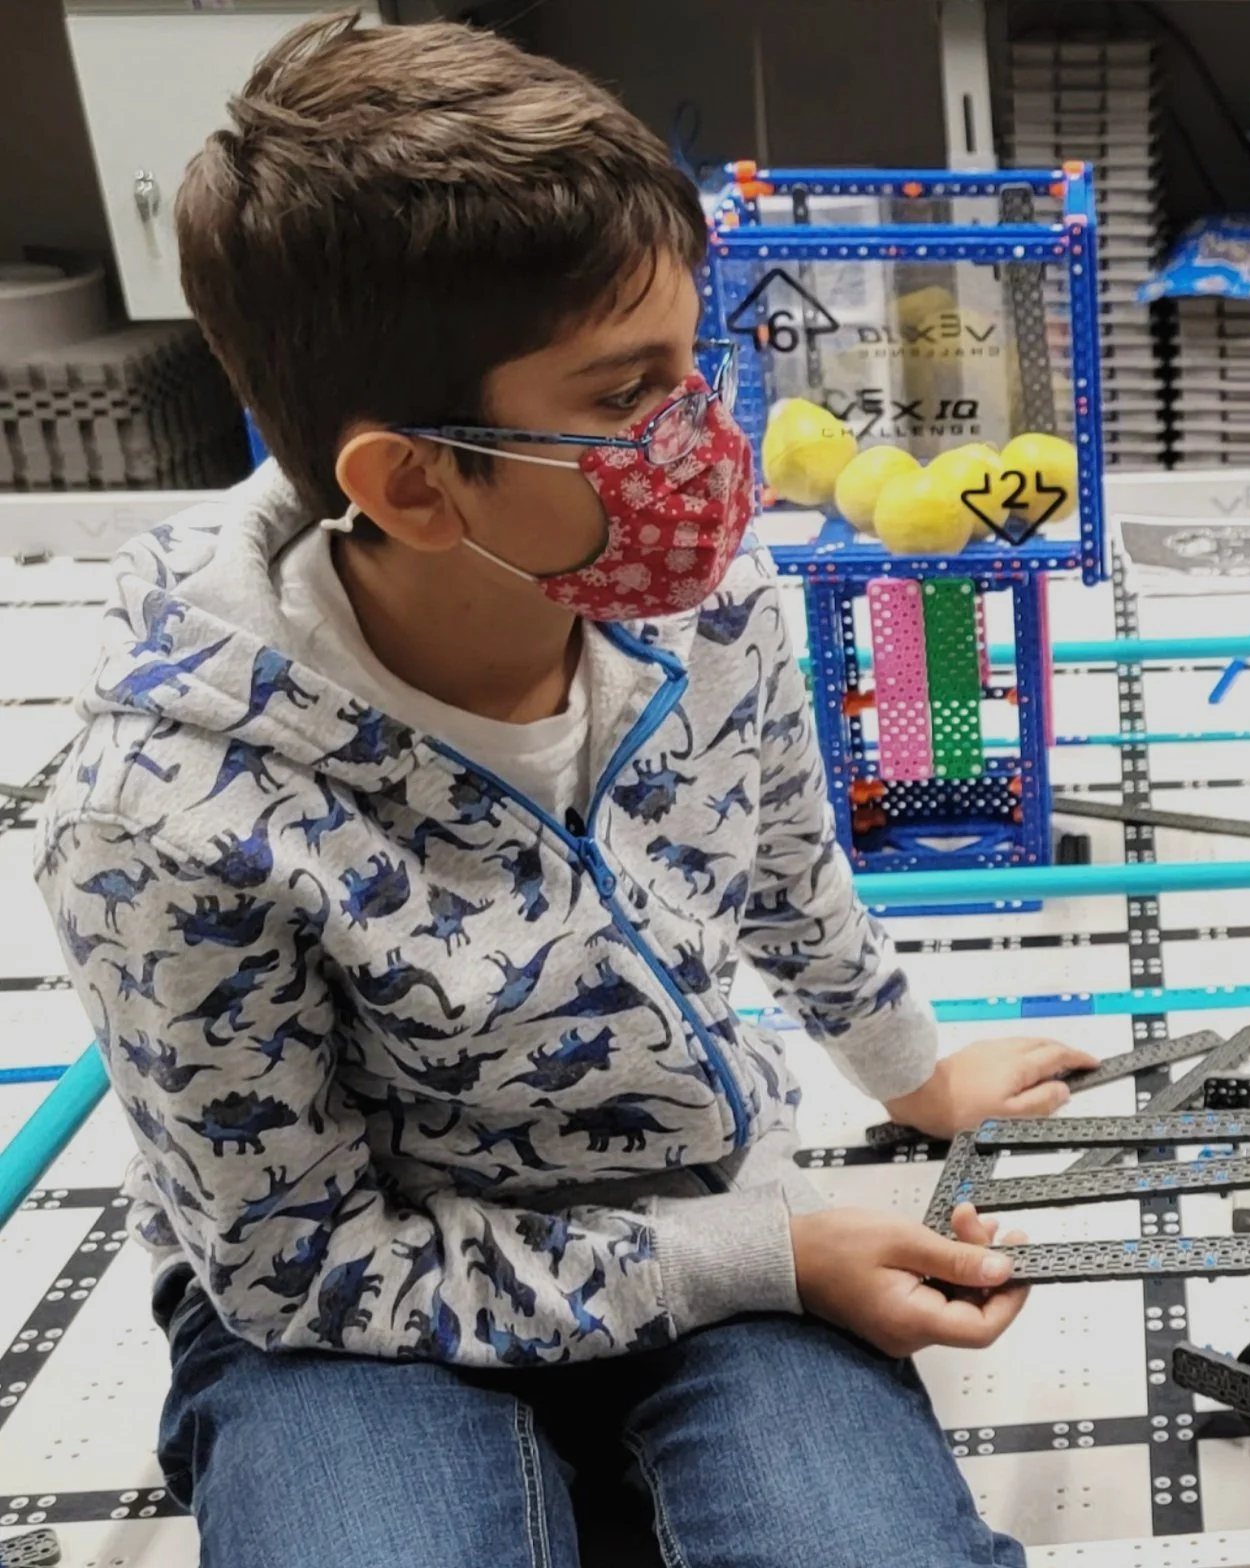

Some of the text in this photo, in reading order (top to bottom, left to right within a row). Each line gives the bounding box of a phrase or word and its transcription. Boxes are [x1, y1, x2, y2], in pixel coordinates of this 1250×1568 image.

[767, 311, 800, 353] 6
[821, 387, 980, 422] VEX IQ
[821, 425, 983, 439] CHALLENGE
[1000, 470, 1031, 510] 2
